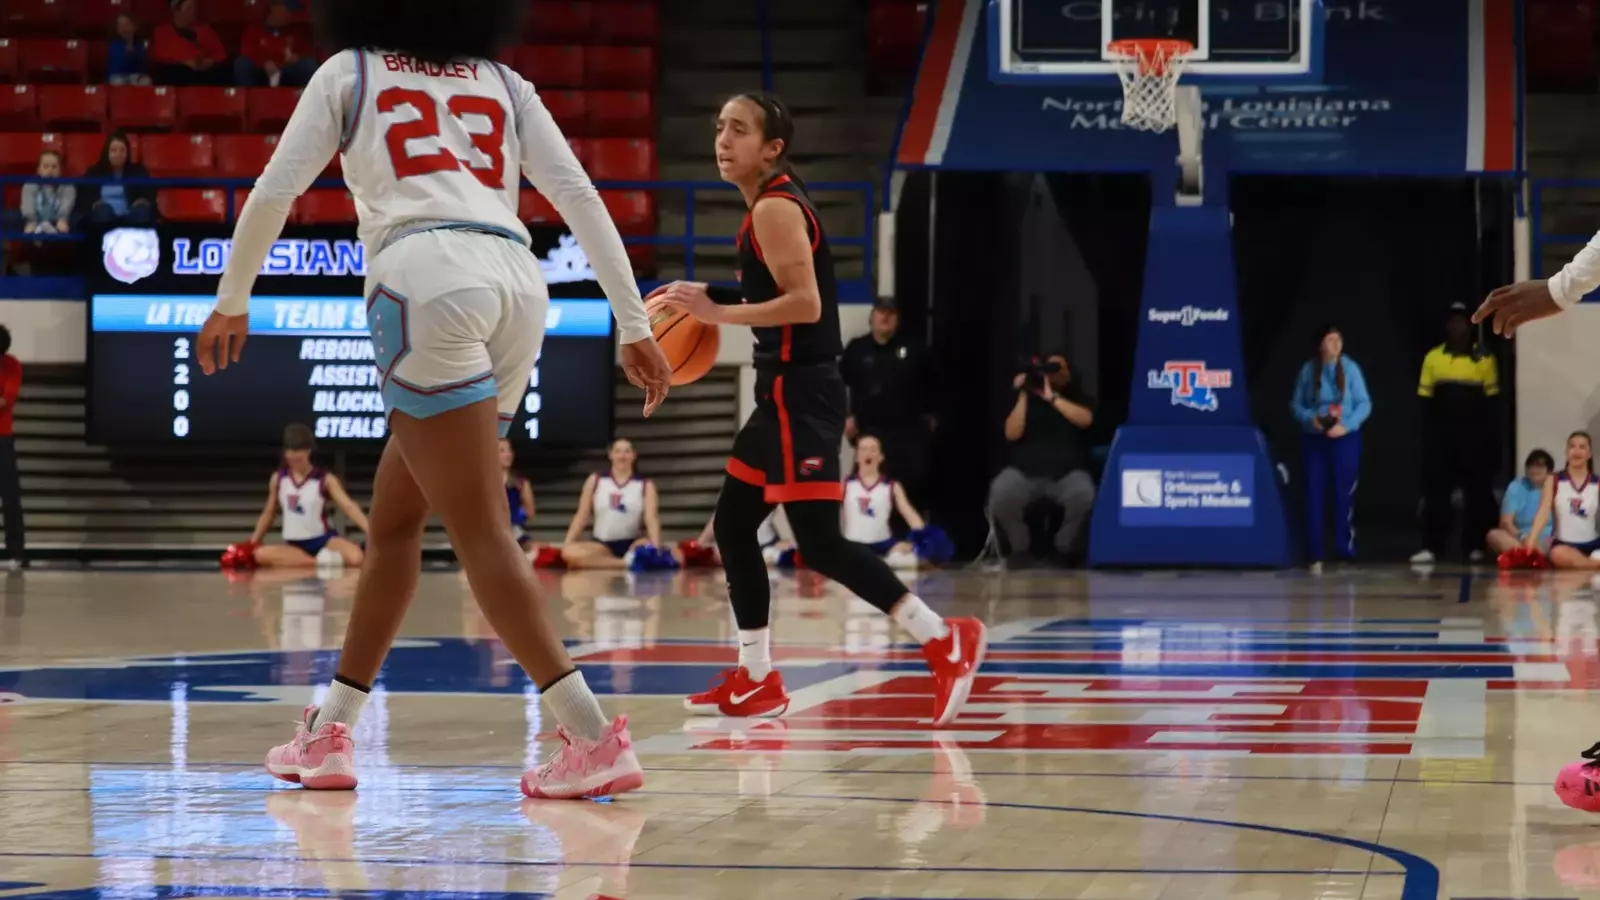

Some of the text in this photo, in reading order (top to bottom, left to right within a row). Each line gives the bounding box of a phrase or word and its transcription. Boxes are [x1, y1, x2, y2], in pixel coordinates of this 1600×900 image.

[1254, 1, 1384, 21] Bnk
[383, 54, 478, 80] BRADLEY
[1223, 97, 1391, 112] Louisiana
[1230, 113, 1356, 129] Center
[376, 86, 506, 190] 23
[173, 238, 368, 275] LOSIAN
[174, 303, 213, 325] TEC
[273, 303, 345, 329] TEAM
[174, 338, 189, 358] 2
[299, 338, 376, 360] REBOUN
[174, 364, 189, 384] 2
[308, 364, 378, 386] ASSIST
[174, 390, 189, 411] 0
[525, 392, 541, 413] 0
[174, 416, 189, 437] 0
[315, 416, 386, 438] STEALS
[525, 417, 539, 439] 1
[1165, 495, 1251, 509] Sports Medicine
